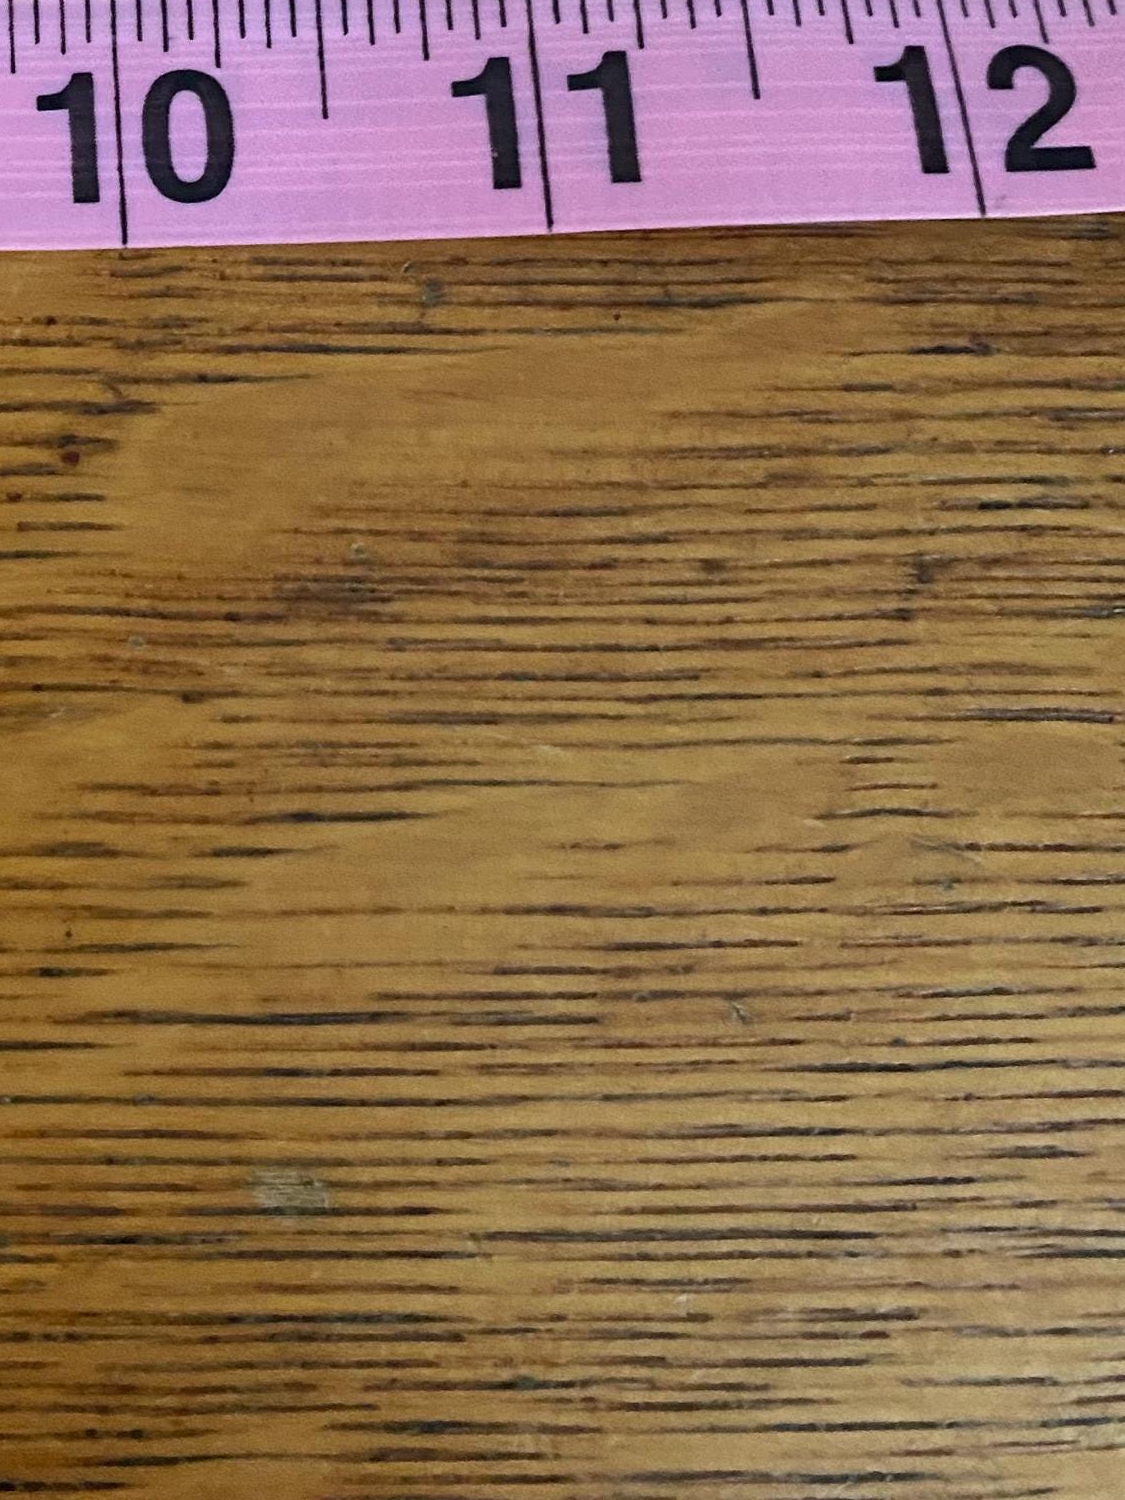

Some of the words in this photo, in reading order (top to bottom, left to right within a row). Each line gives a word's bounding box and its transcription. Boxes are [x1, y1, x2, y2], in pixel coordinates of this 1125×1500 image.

[37, 69, 235, 203] 10
[451, 51, 642, 189] 11
[874, 45, 1096, 174] 12
